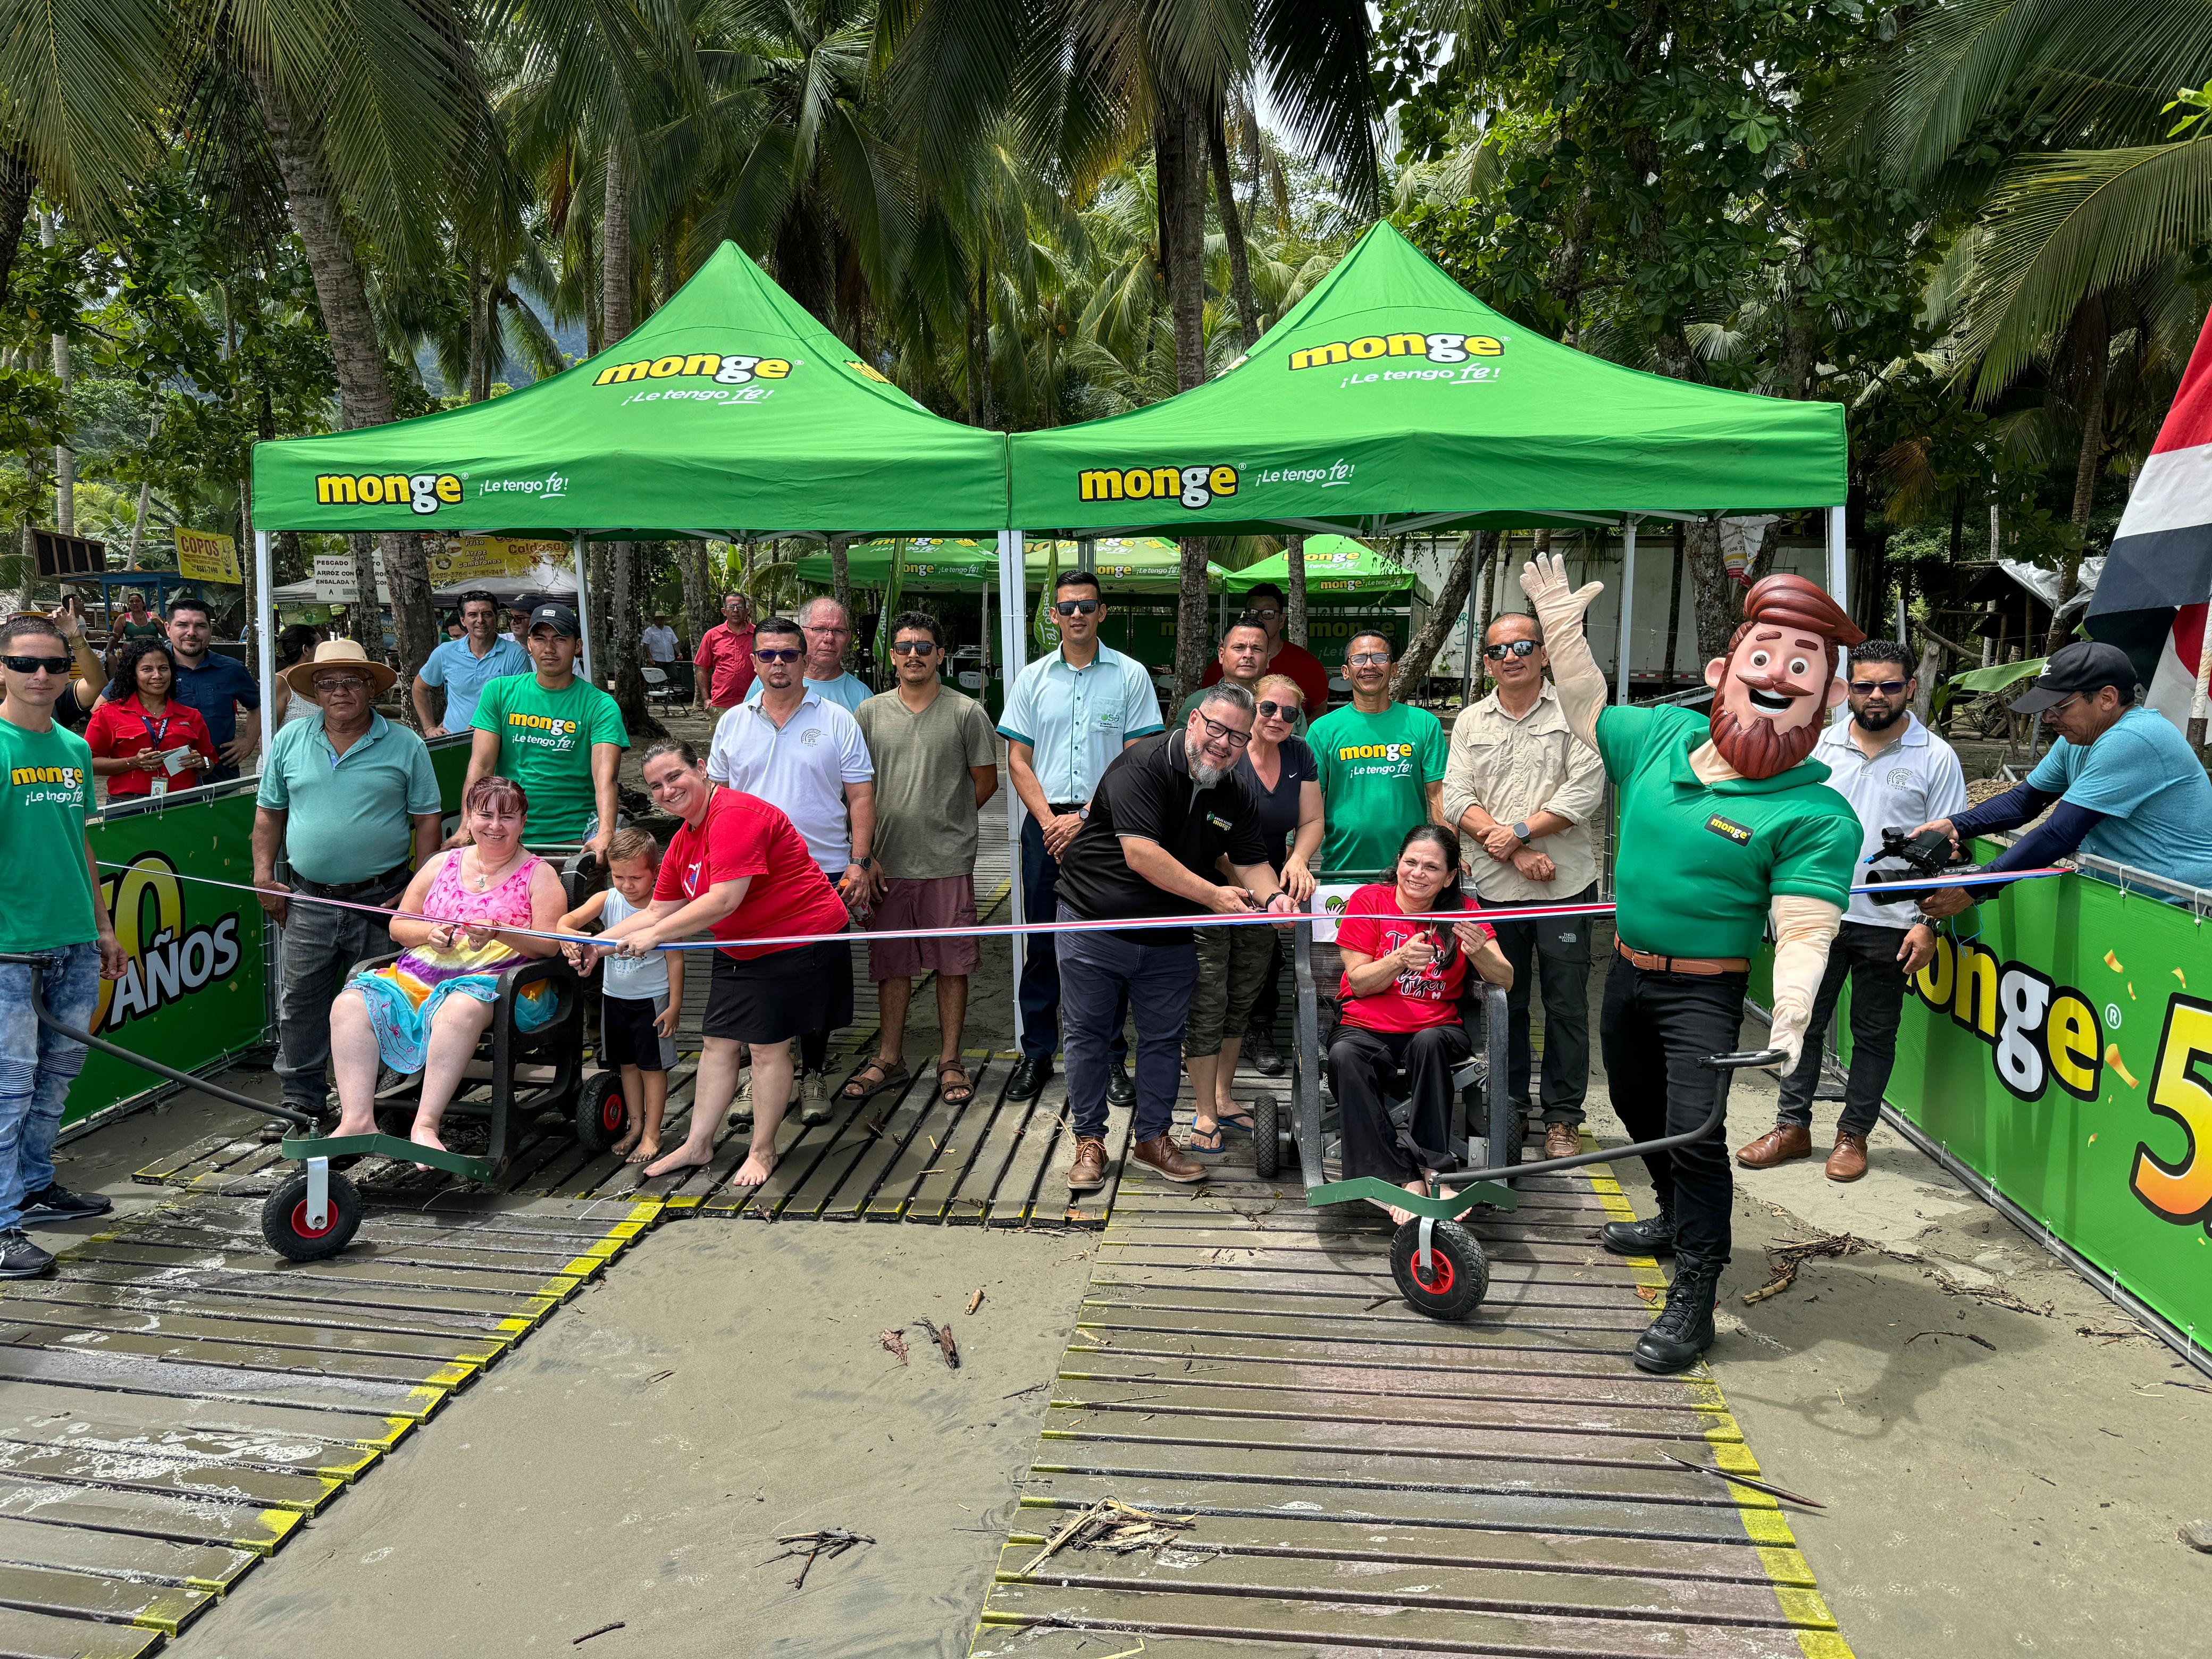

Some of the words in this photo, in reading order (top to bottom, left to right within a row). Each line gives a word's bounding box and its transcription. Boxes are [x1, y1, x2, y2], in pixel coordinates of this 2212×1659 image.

[1289, 332, 1504, 370] monge
[592, 353, 793, 384] monge
[1340, 373, 1379, 389] ¡Le
[1382, 369, 1454, 380] tengo
[1460, 363, 1501, 379] fe!
[622, 391, 660, 406] ¡Le
[665, 389, 729, 400] tengo
[731, 384, 775, 400] fe!
[316, 473, 464, 515] monge
[479, 480, 500, 496] ¡Le
[502, 480, 543, 494] tengo
[546, 472, 568, 492] fe!
[1079, 464, 1238, 509] monge
[1256, 470, 1280, 487] ¡Le
[1282, 469, 1327, 483] tengo
[1329, 458, 1354, 480] fe!
[181, 535, 220, 557] COPOS
[1320, 579, 1363, 591] monge
[508, 713, 576, 736] monge
[512, 733, 526, 743] ¡Le
[527, 735, 556, 747] tengo
[557, 735, 575, 748] fe!
[1339, 743, 1413, 762] monge
[12, 766, 83, 789] monge
[1350, 766, 1365, 778] ¡Le
[1366, 765, 1396, 775] tengo
[1397, 759, 1413, 774] fe!
[26, 791, 44, 806] ¡Le
[1213, 819, 1231, 831] monge
[1711, 818, 1747, 839] monge
[110, 918, 238, 1026] AÑOS
[1906, 931, 2104, 1102] onge
